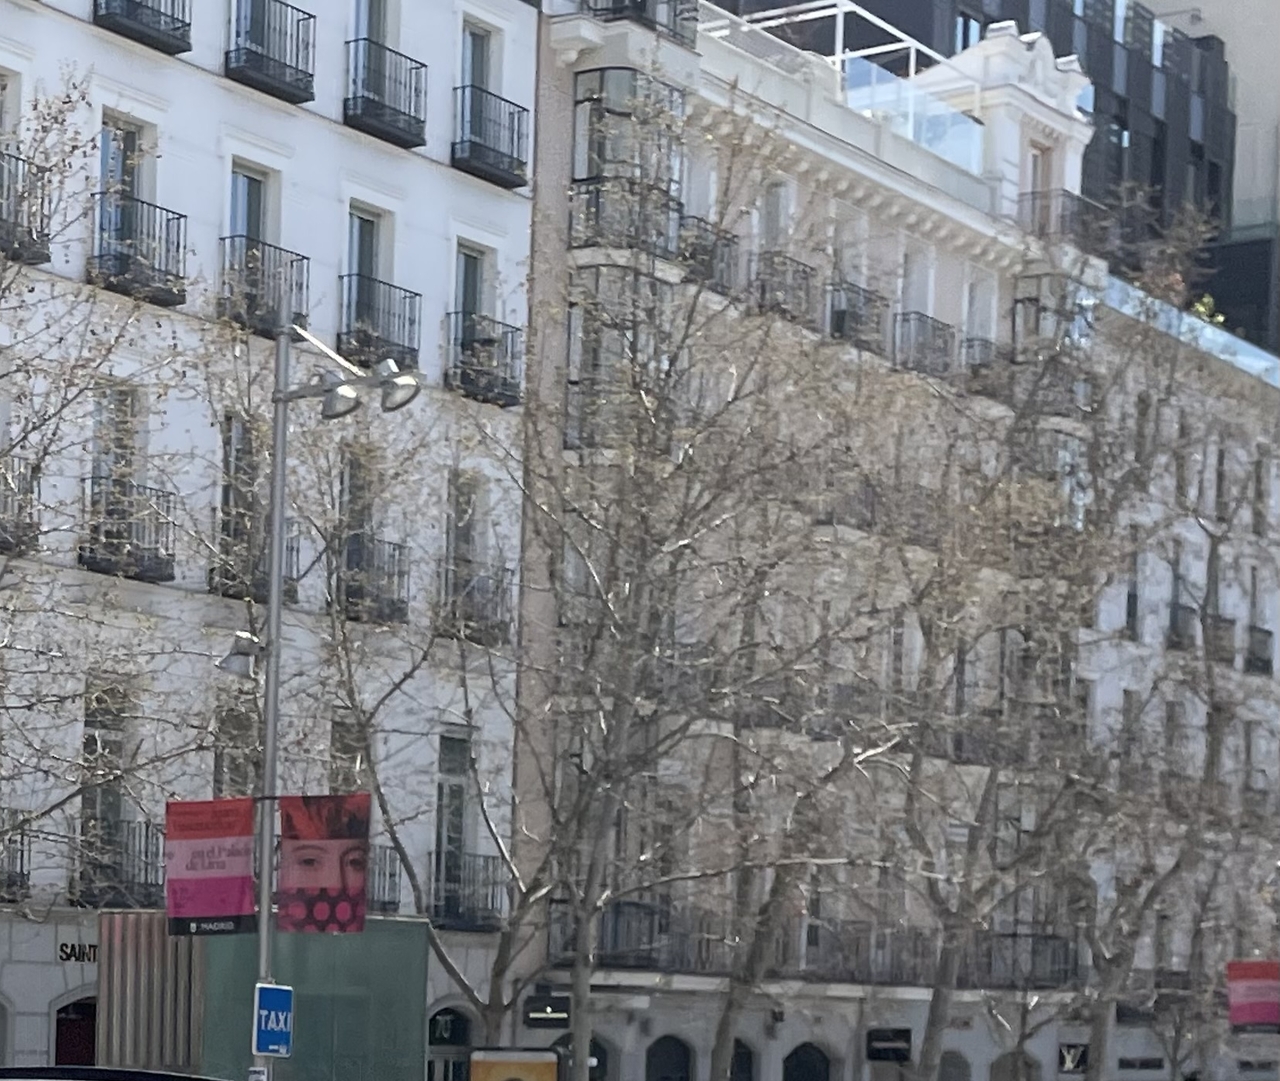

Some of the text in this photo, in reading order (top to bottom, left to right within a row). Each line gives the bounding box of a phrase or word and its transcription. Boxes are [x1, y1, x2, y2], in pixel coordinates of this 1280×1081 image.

[200, 921, 234, 931] MADRID
[59, 942, 98, 963] SAINT
[260, 1010, 291, 1032] TAXI
